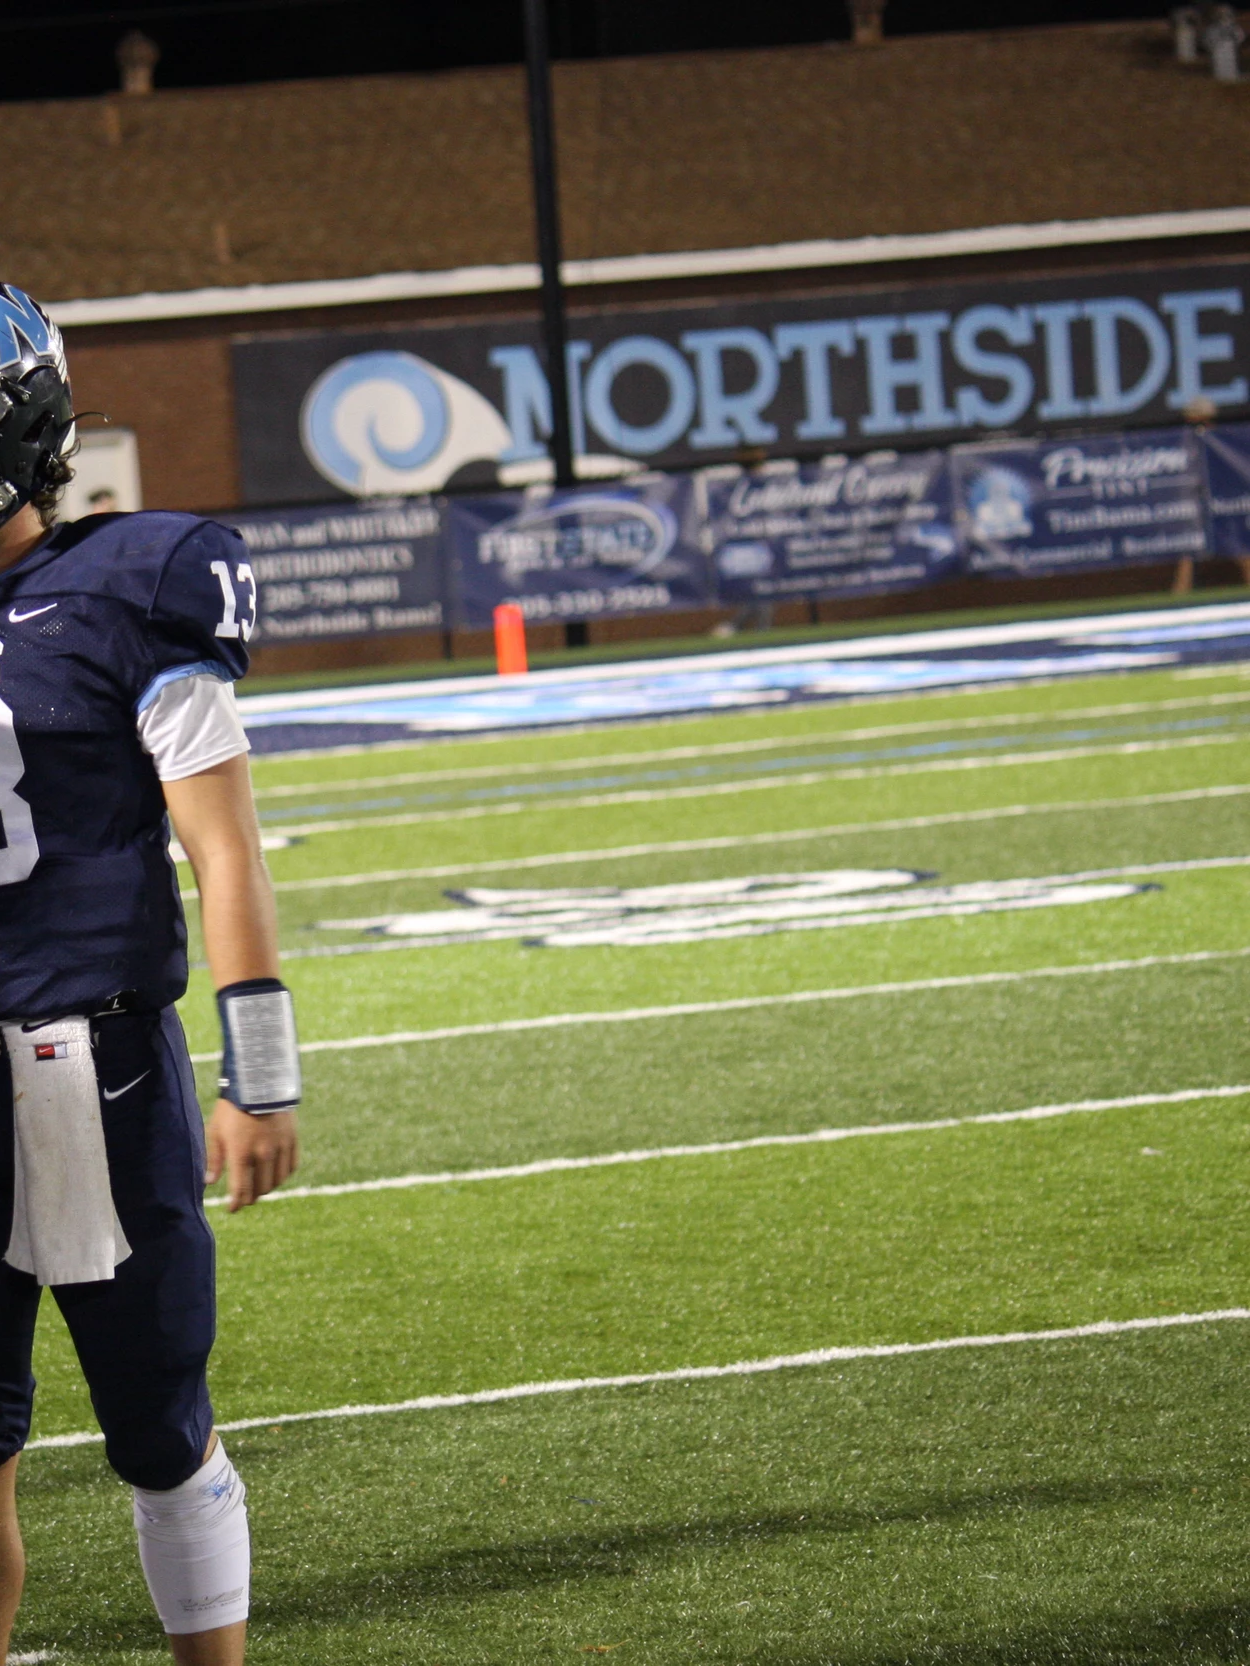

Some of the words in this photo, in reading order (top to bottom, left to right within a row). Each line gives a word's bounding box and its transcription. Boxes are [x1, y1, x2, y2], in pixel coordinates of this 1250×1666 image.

[487, 287, 1248, 464] NORTHSIDE
[239, 522, 291, 548] WAN
[210, 560, 257, 643] 13
